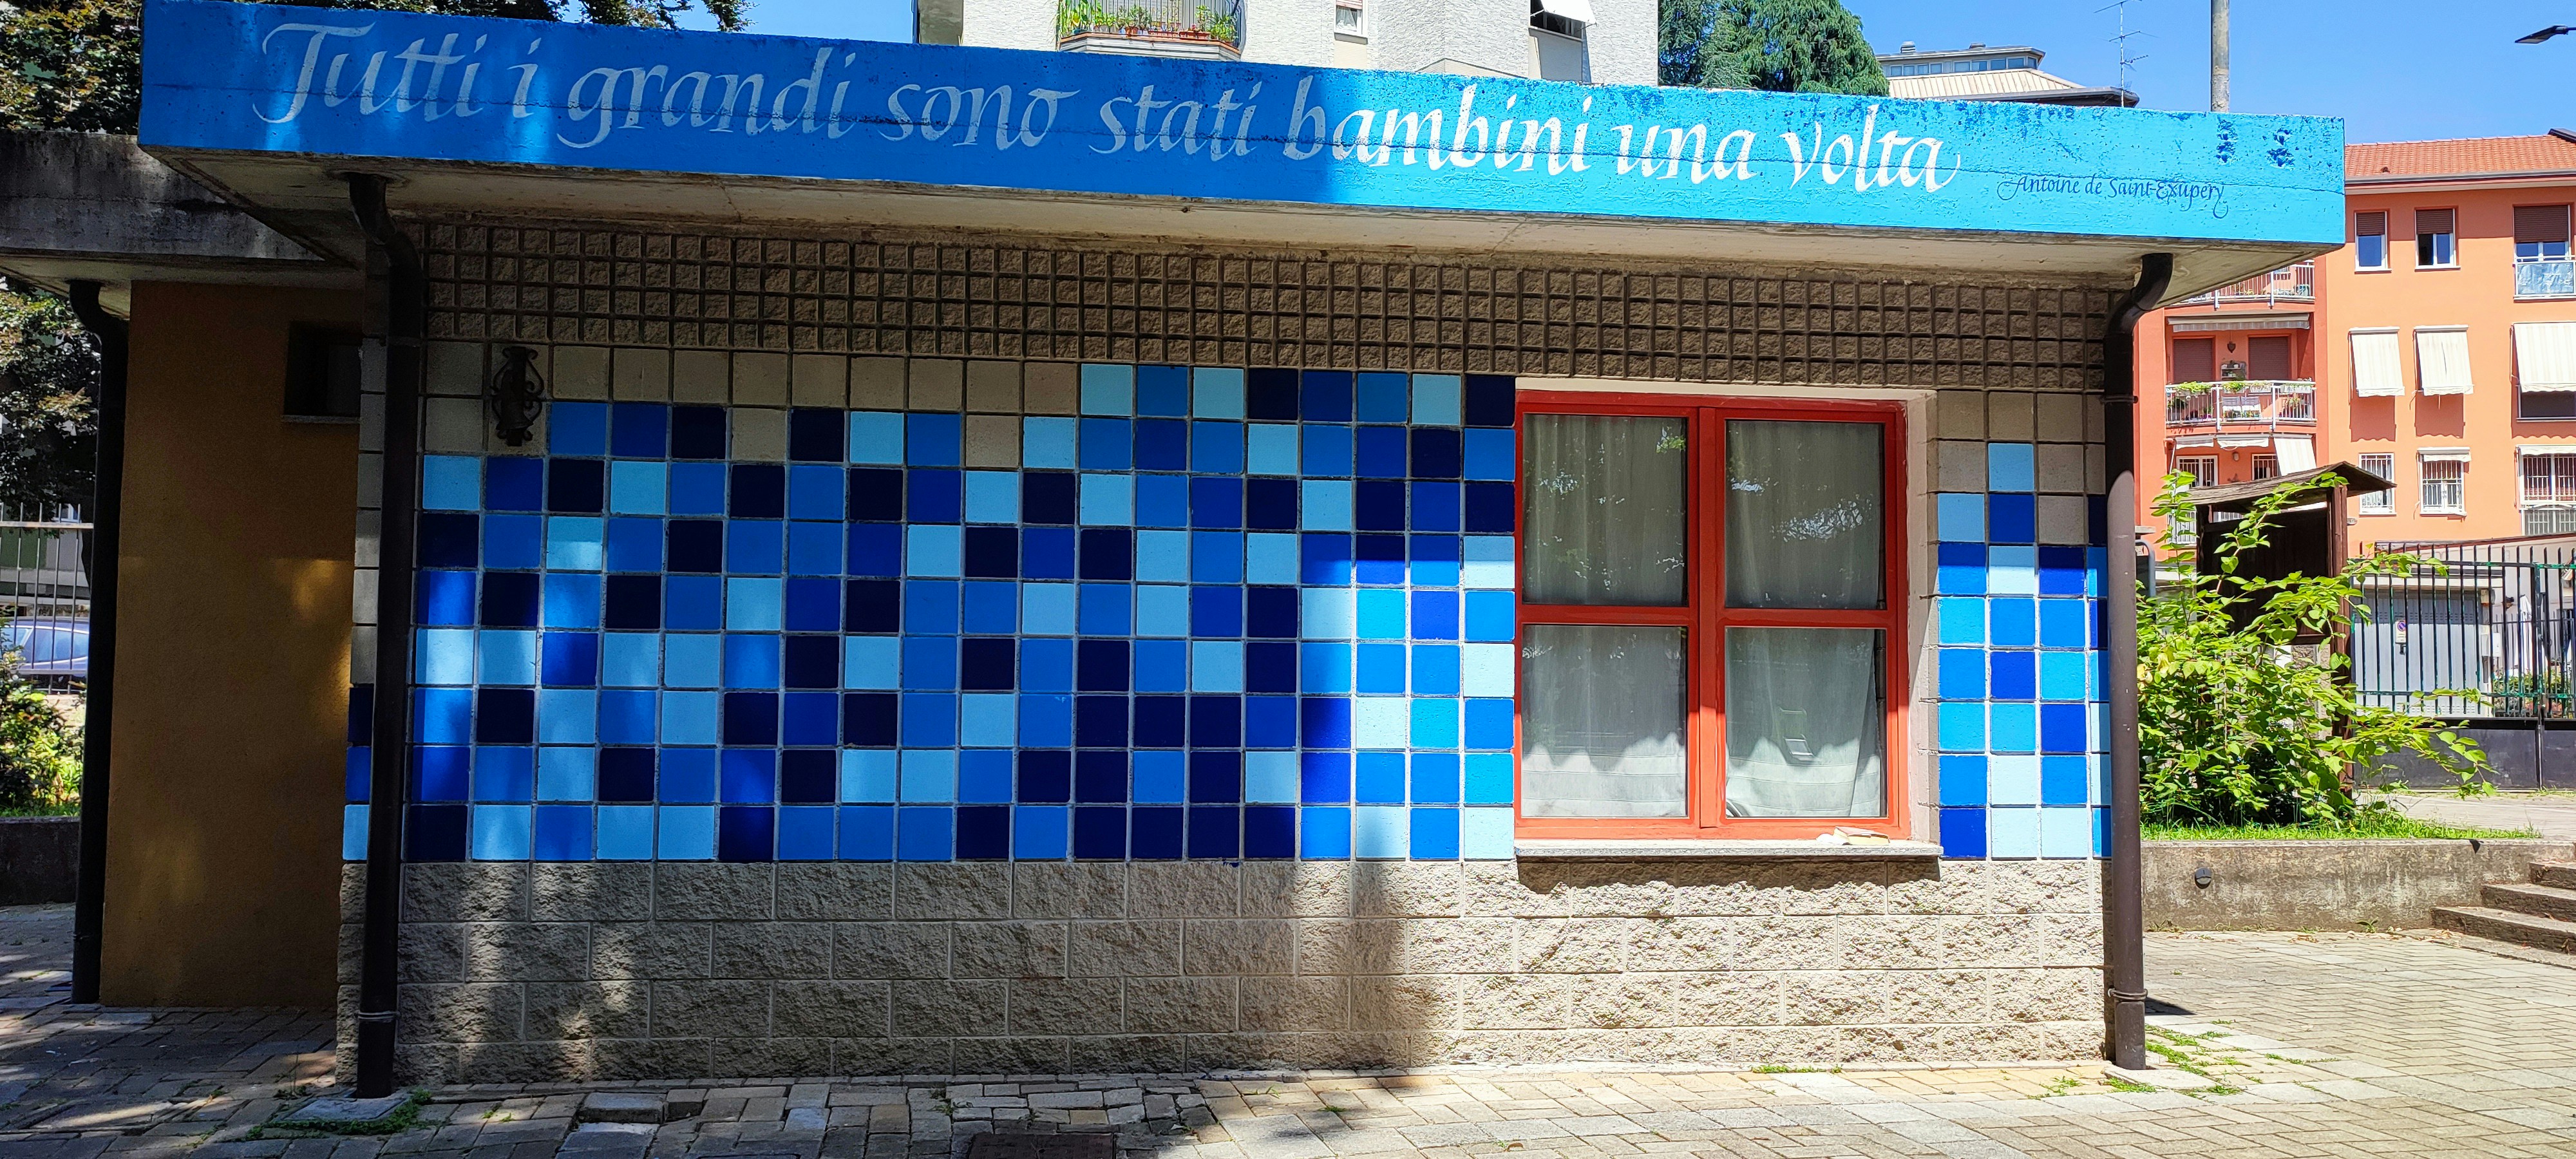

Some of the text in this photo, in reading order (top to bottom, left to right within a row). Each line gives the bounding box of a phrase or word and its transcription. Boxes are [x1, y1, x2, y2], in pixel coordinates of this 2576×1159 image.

[252, 21, 1962, 193] Tutti i grandi sono stati bambini una volta
[1997, 175, 2080, 201] Antoine
[2085, 173, 2103, 195] de
